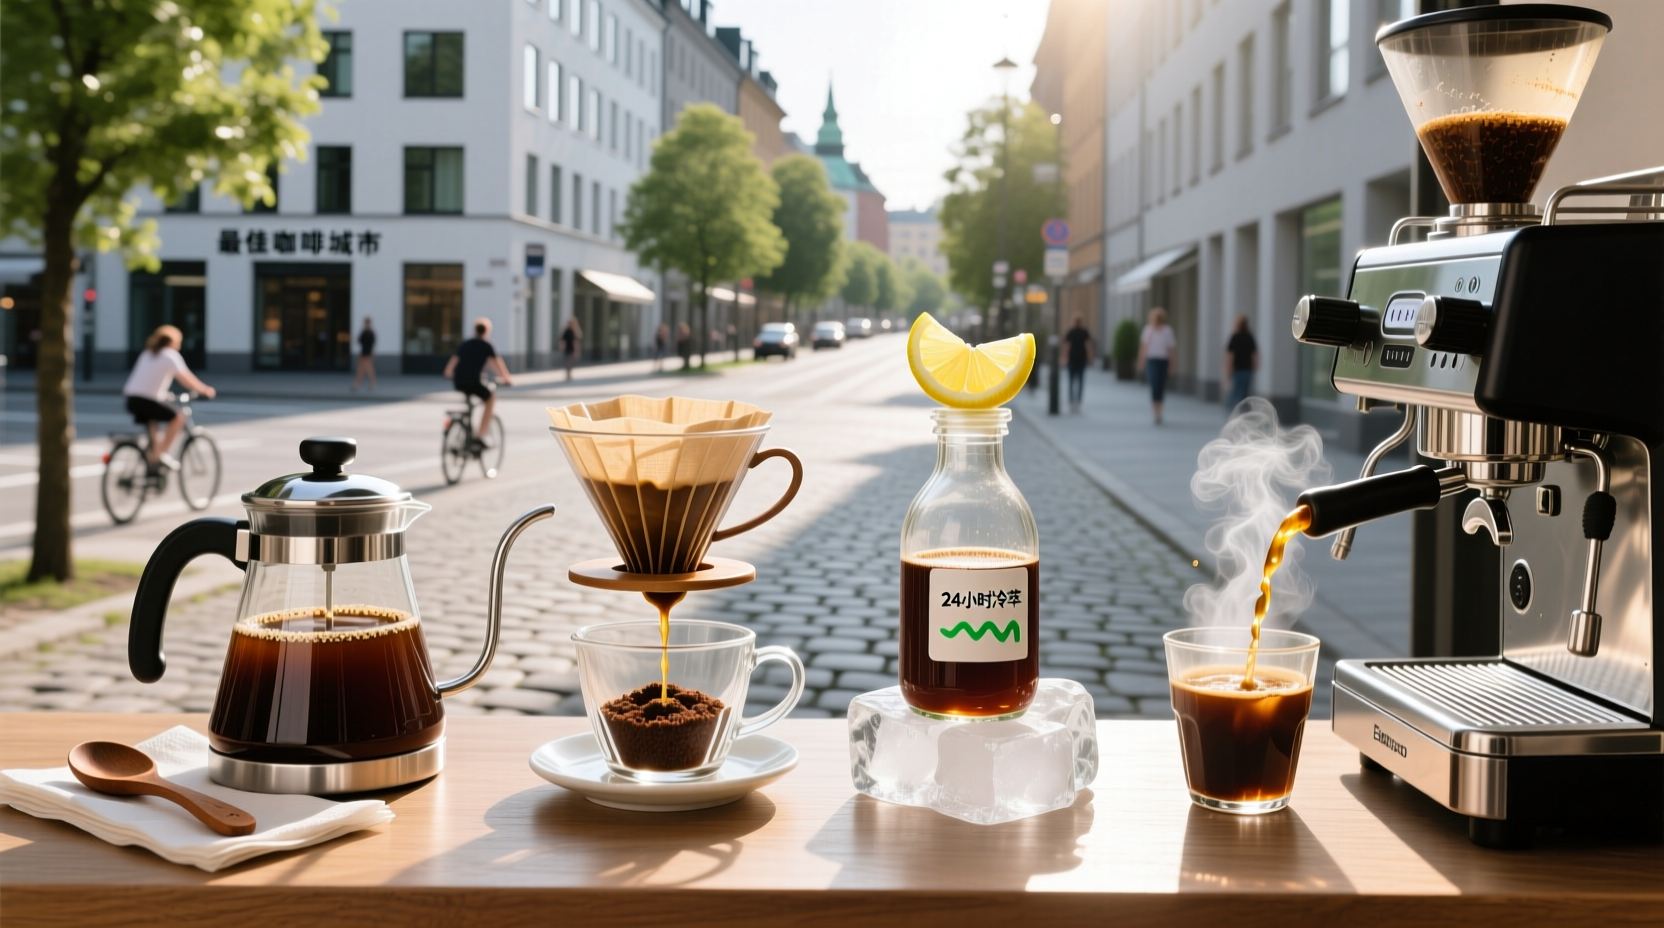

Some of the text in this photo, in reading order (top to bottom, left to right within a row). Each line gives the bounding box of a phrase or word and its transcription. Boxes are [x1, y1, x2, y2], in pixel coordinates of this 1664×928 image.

[218, 229, 382, 256] 最佳咖啡城市
